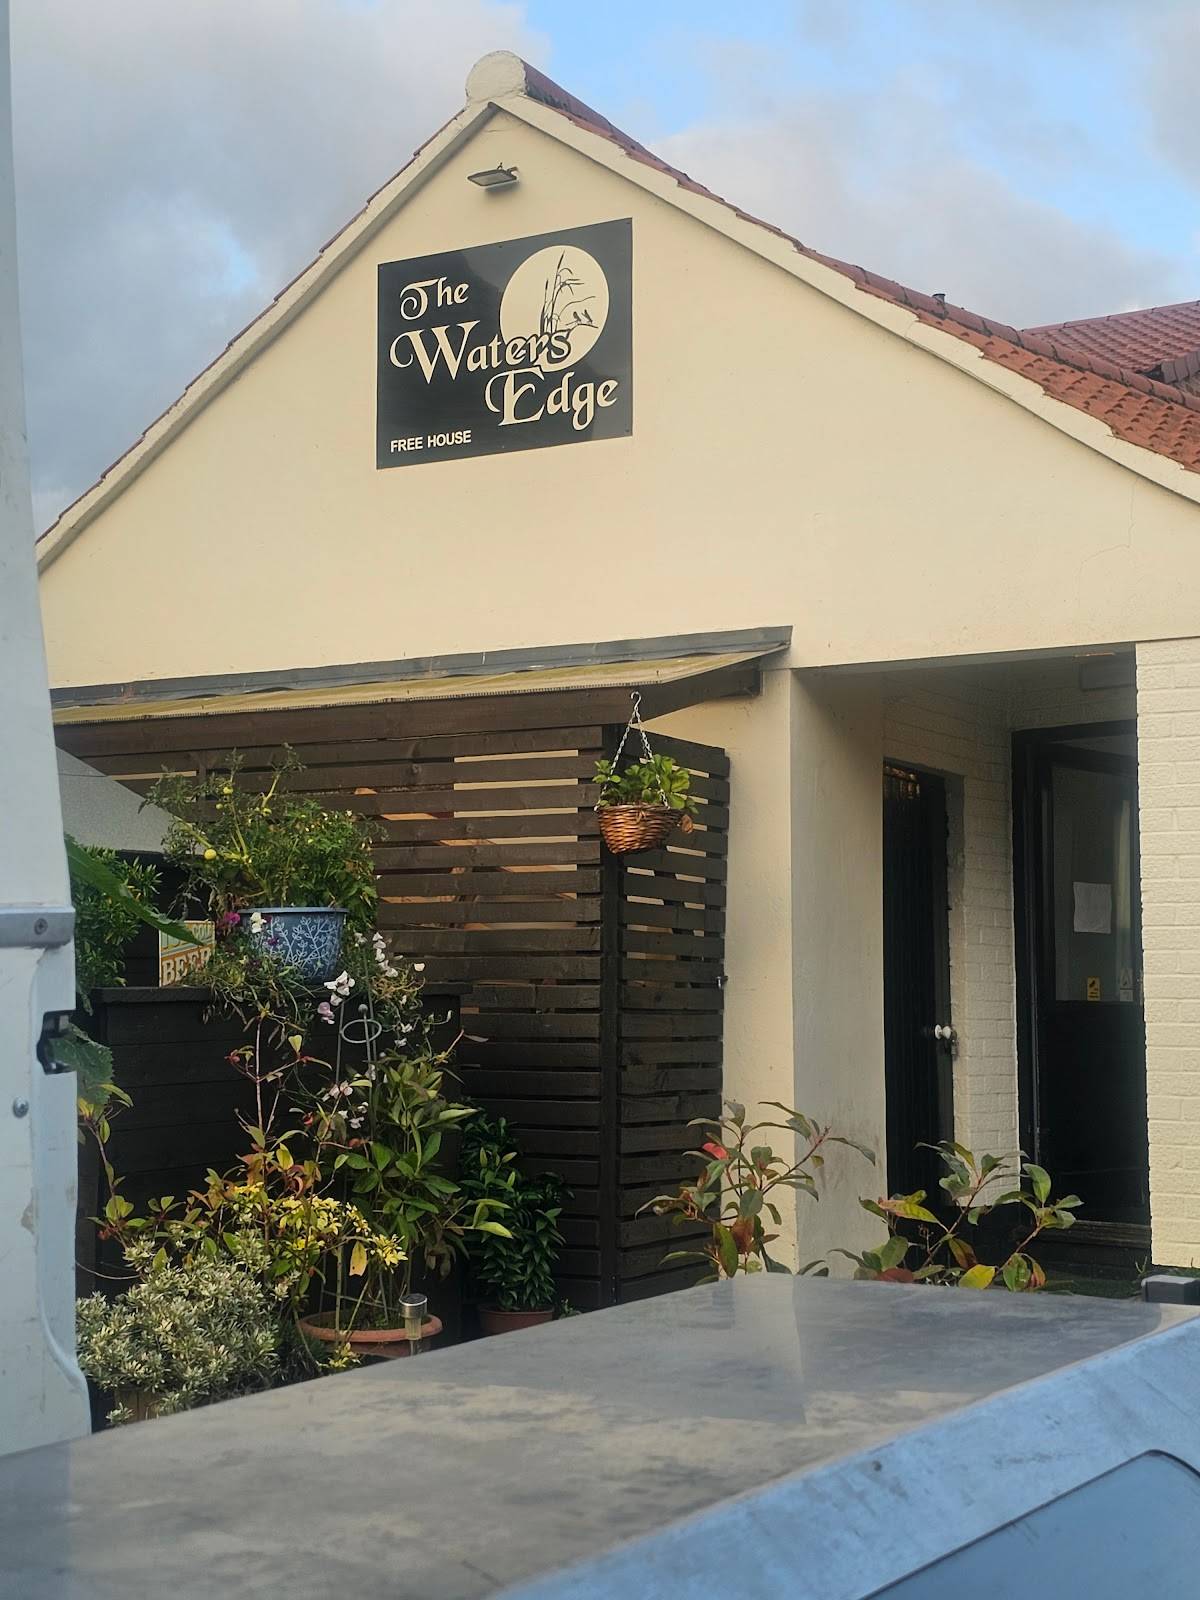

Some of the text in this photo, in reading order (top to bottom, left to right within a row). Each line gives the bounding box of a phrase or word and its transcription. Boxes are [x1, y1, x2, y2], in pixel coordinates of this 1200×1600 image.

[400, 277, 470, 321] The
[390, 320, 571, 385] Waters
[485, 366, 619, 431] Edge
[390, 430, 472, 453] FREE HOUSE
